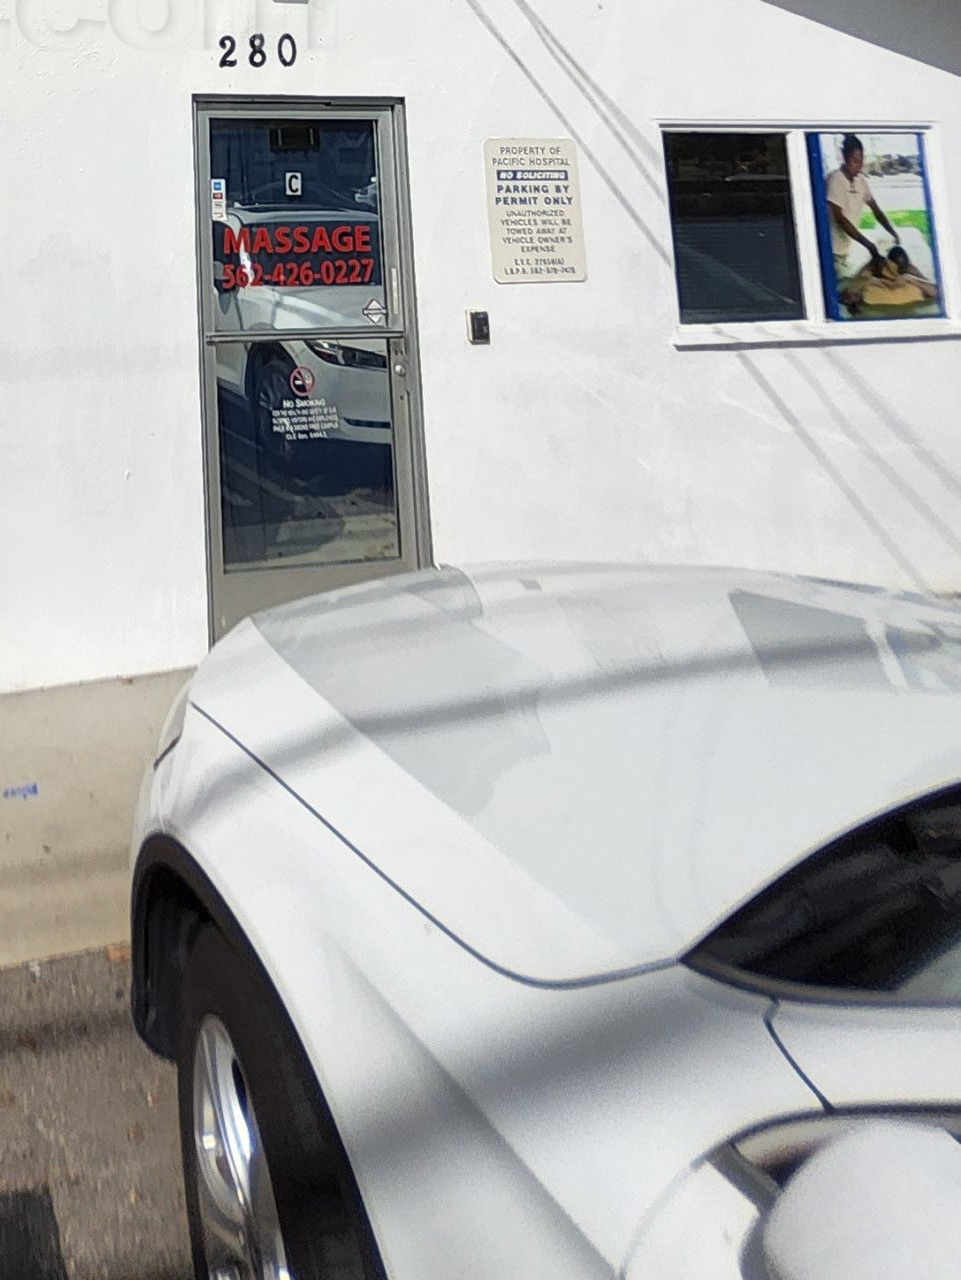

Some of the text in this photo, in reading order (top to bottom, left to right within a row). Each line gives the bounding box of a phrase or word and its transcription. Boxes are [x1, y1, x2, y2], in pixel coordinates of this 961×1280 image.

[219, 33, 297, 68] 280
[500, 147, 545, 155] PROPERTY
[492, 158, 570, 166] PACIFIC HOSPITAL
[288, 175, 299, 194] C
[497, 185, 570, 193] PARKING BY
[495, 197, 573, 205] PERMIT ONLY
[223, 226, 372, 254] MASSAGE
[222, 259, 374, 289] 562-426-0227
